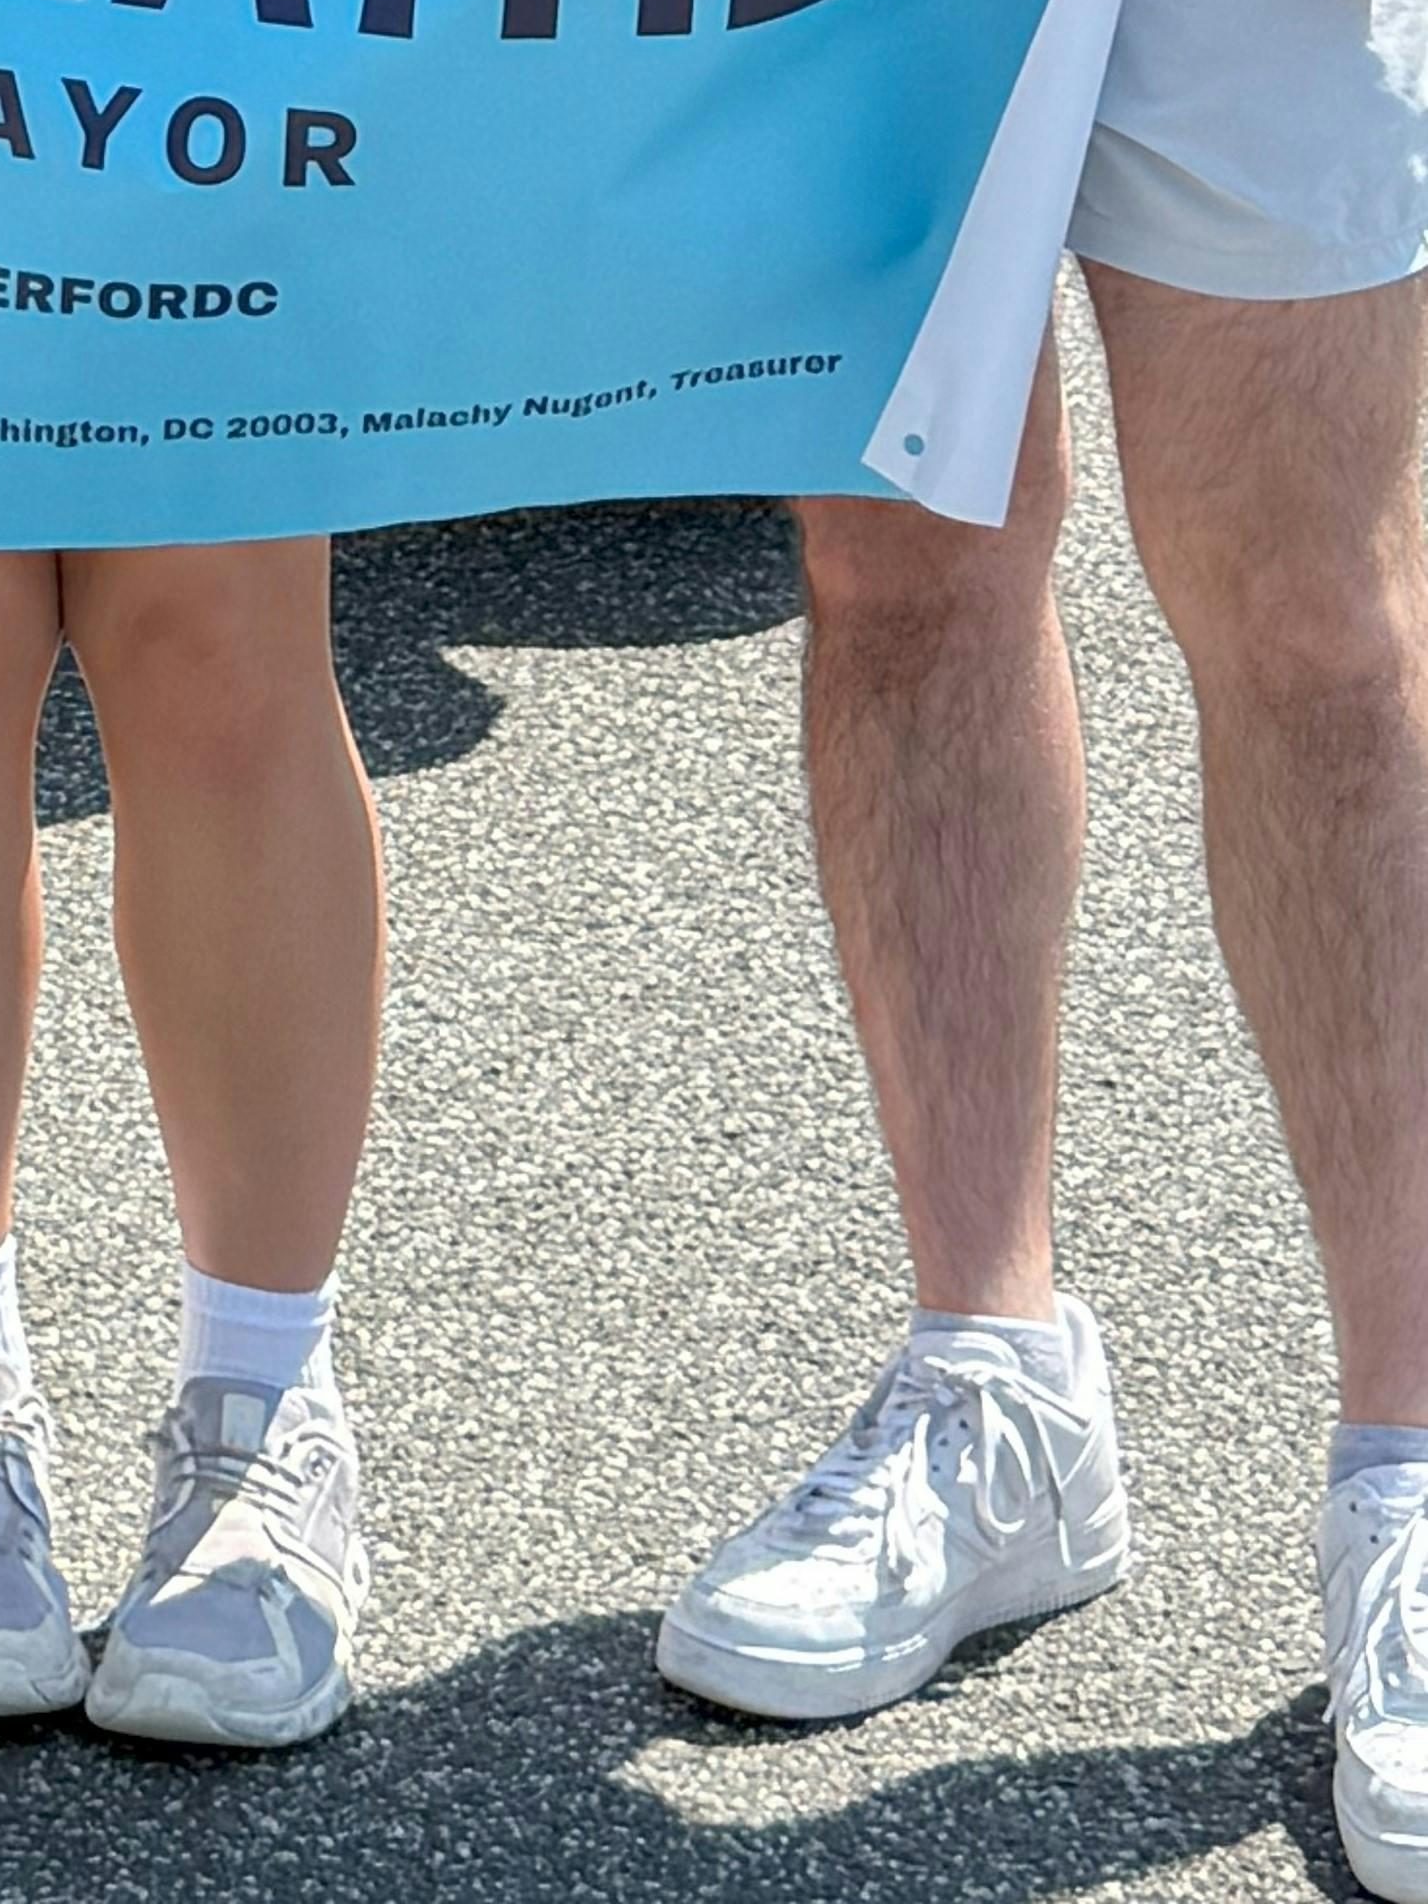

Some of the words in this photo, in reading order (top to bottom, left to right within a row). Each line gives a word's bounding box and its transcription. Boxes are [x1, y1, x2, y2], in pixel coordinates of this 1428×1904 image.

[163, 417, 214, 441] DC
[226, 412, 349, 438] 20003,
[362, 403, 512, 434] Malachy
[522, 380, 657, 418] Nugent,
[671, 353, 843, 391] Treasurer
